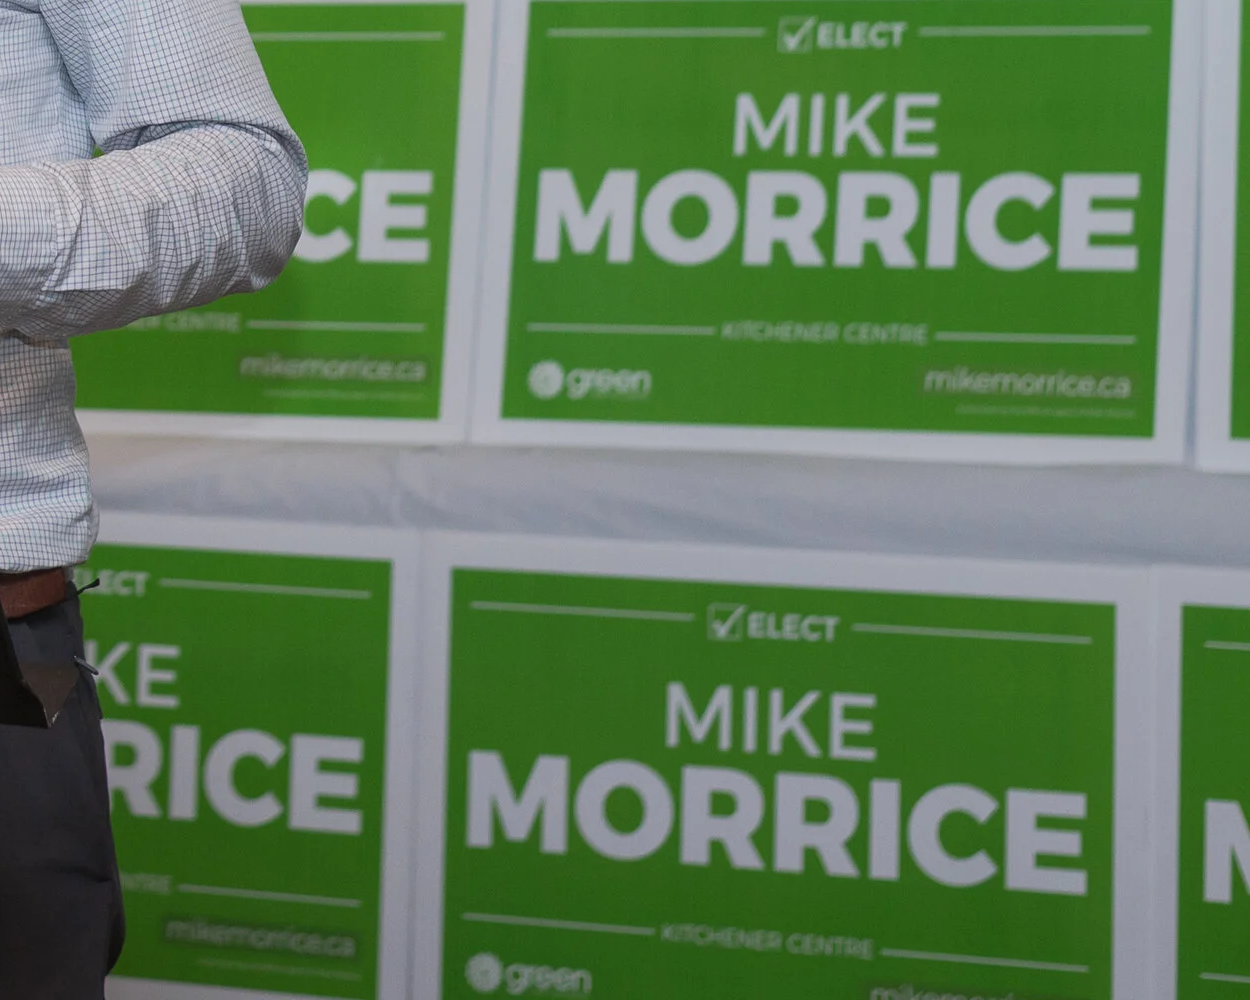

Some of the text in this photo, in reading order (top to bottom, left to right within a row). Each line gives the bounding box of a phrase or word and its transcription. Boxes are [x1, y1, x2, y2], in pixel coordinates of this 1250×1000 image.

[816, 21, 907, 49] ELECT
[733, 93, 940, 158] MIKE
[292, 168, 434, 263] CE
[534, 169, 1141, 272] MORRICE
[720, 320, 928, 346] KITCHENER CENTRE
[567, 368, 652, 399] green
[923, 366, 1133, 399] mikemorrice.ca
[75, 568, 148, 597] LECT
[747, 611, 840, 642] ELECT
[85, 640, 182, 710] KE
[665, 682, 877, 761] MIKE
[104, 717, 364, 835] RICE
[465, 750, 1088, 896] MORRICE
[660, 923, 873, 960] KITCHENER CENTRE
[505, 963, 593, 995] green
